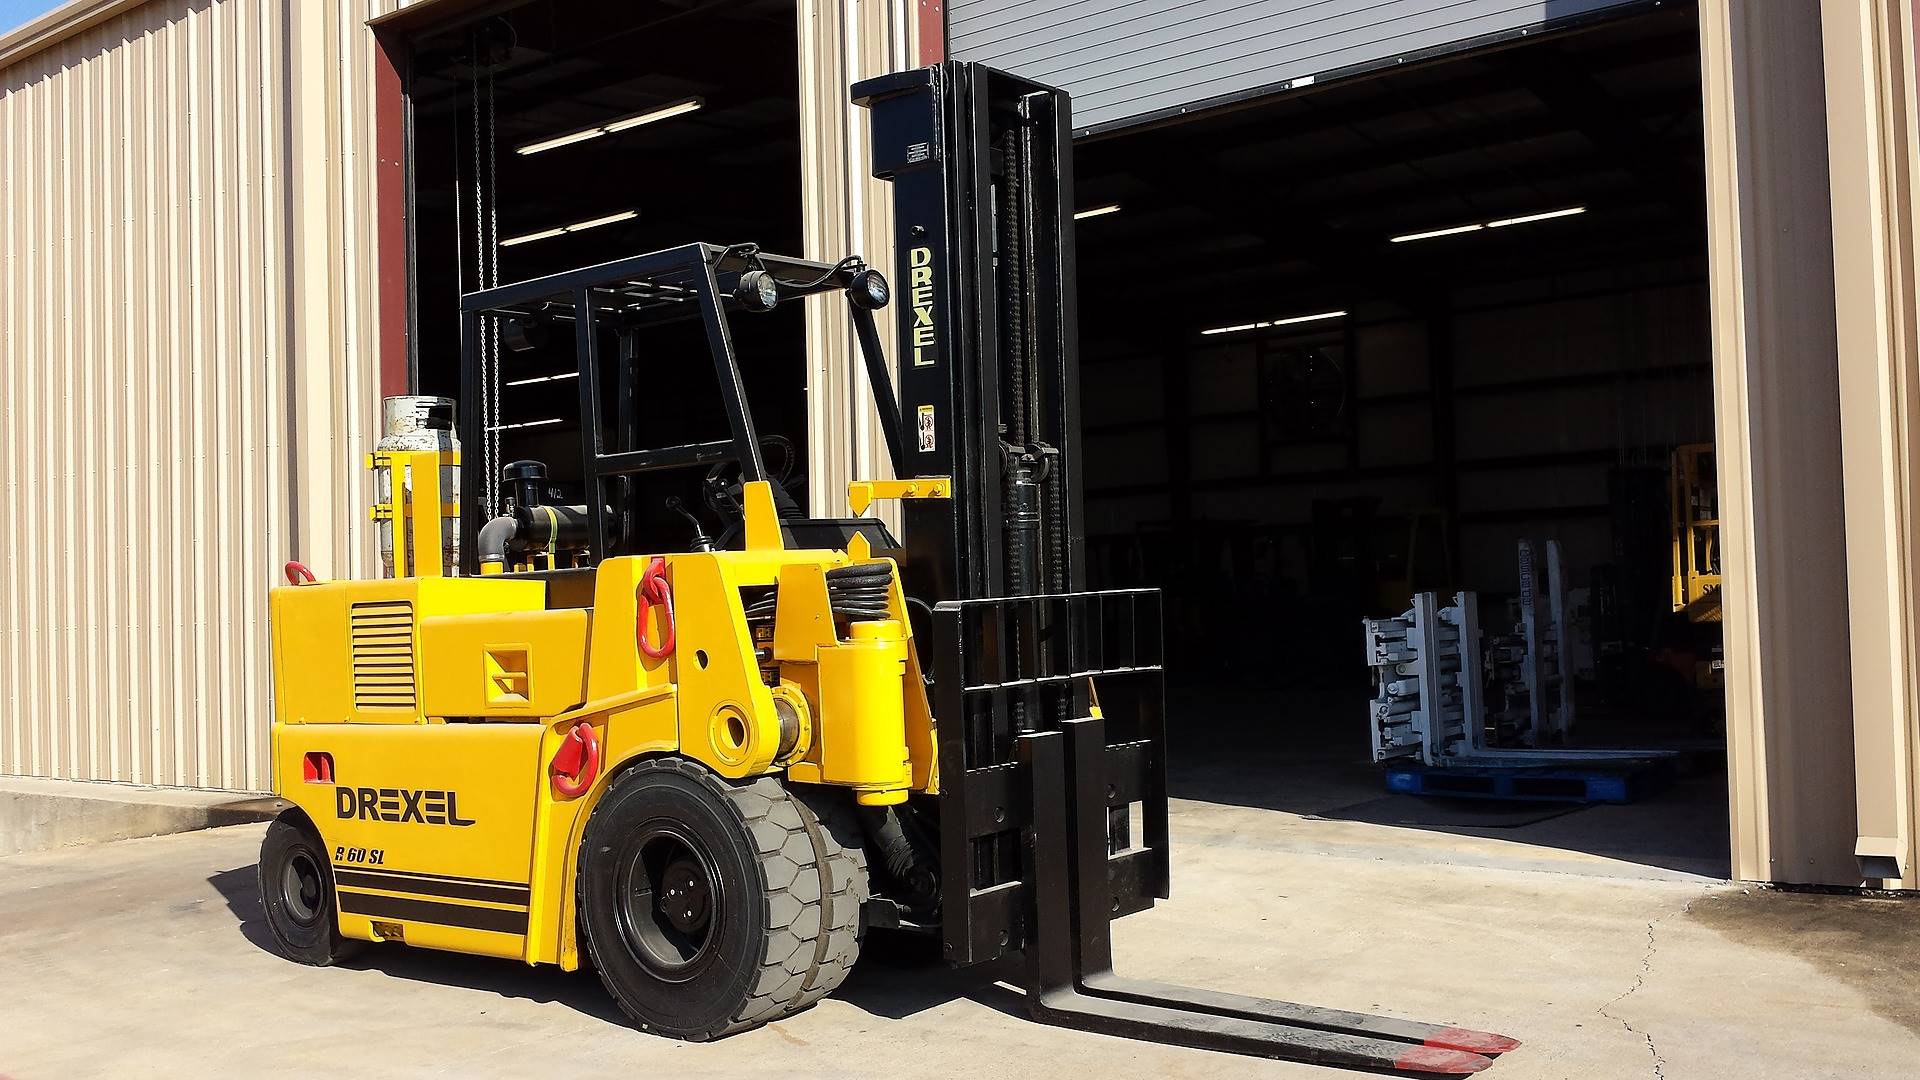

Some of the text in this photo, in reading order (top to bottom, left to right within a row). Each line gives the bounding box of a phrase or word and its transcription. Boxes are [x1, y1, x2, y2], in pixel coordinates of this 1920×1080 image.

[910, 247, 935, 367] DREXEL
[1702, 583, 1722, 597] SM
[335, 786, 477, 827] DREXEL
[334, 846, 385, 865] R 60 SL
